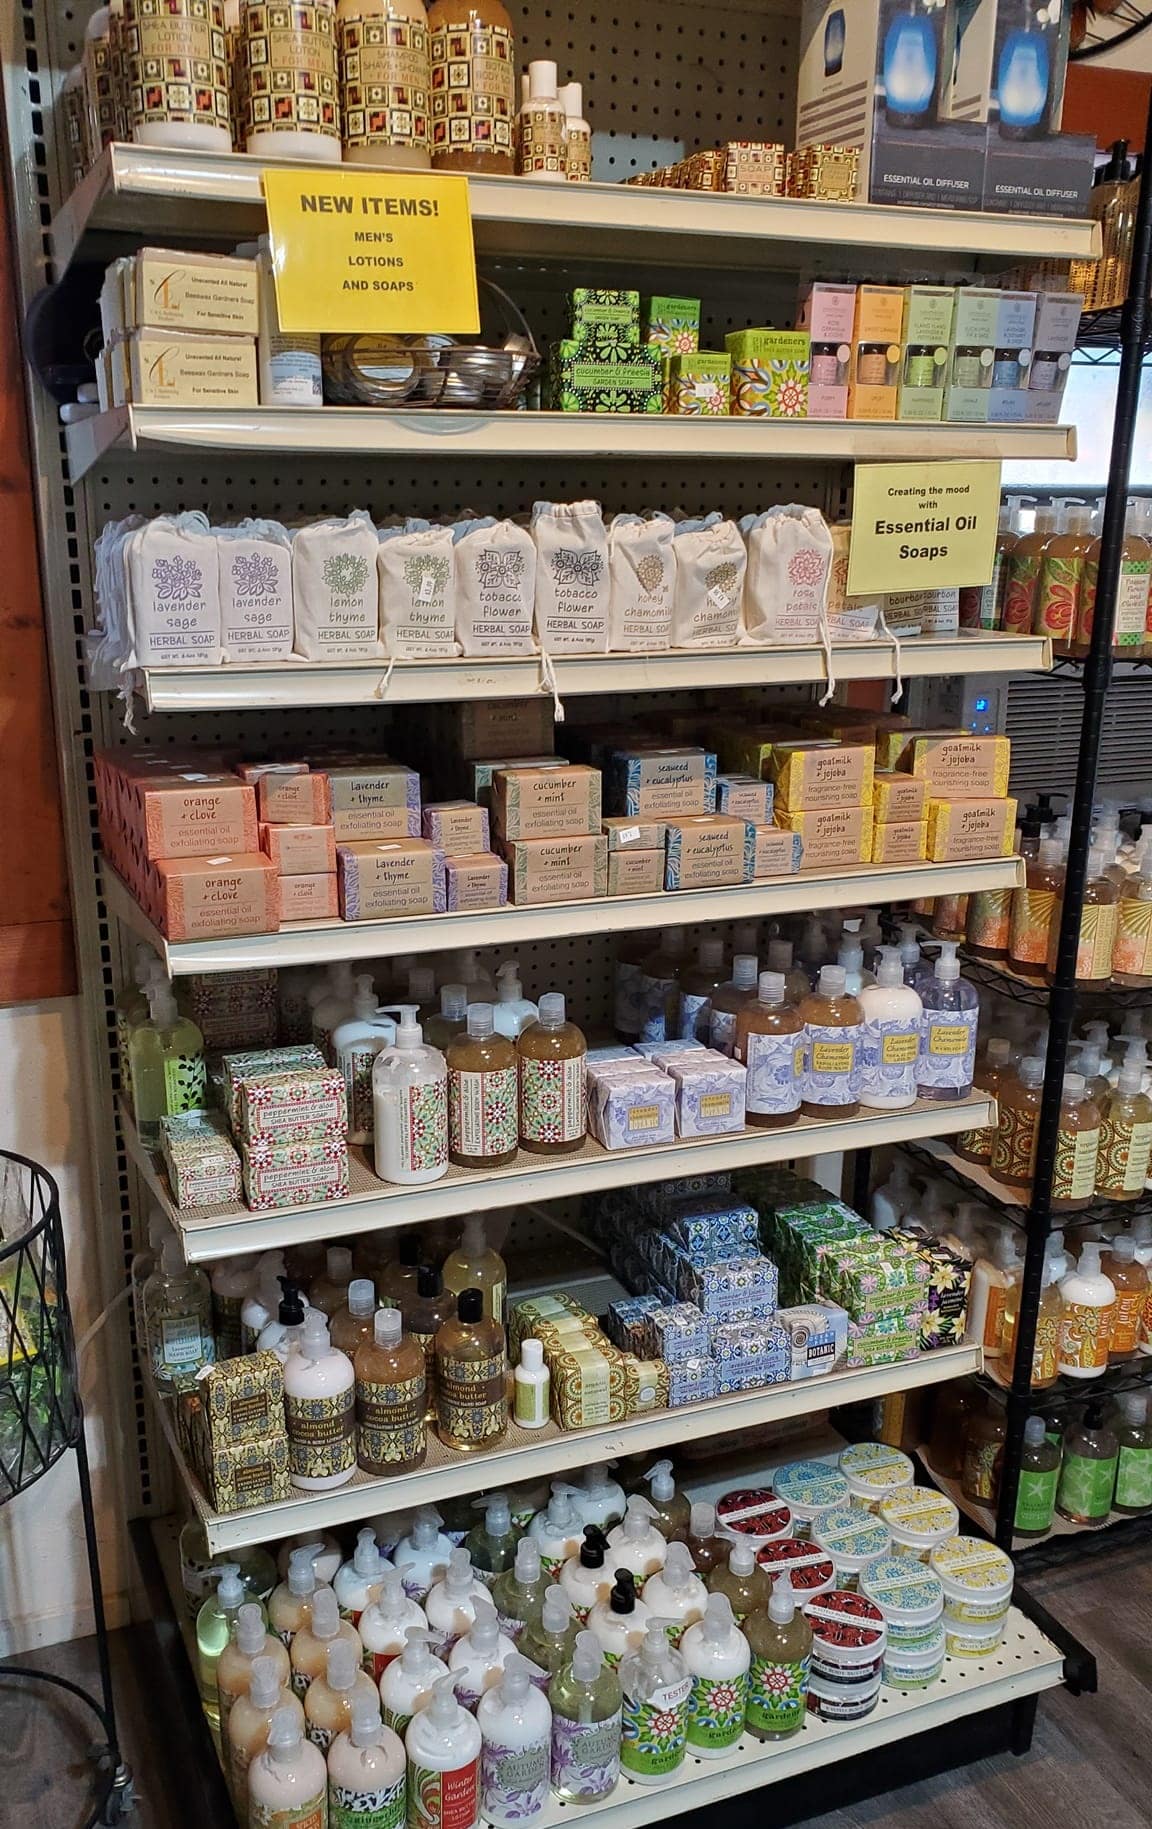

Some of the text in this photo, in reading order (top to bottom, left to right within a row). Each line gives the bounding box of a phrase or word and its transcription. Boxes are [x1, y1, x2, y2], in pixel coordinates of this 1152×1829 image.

[884, 175, 969, 189] ESSENTIAL OIL DIFFUSER
[996, 185, 1078, 198] ESSENTIAL OIL DIFFUSER
[300, 195, 439, 217] NEW ITEMS!
[354, 232, 393, 243] MEN'S
[348, 256, 403, 267] LOTIONS
[342, 280, 414, 291] AND SOAPS
[666, 303, 697, 312] gardeners
[764, 336, 806, 346] gardeners
[576, 367, 613, 376] cucumber
[887, 485, 970, 498] Creating the mood
[918, 500, 938, 509] with
[875, 515, 977, 535] Essential Oil
[899, 545, 948, 560] Soaps
[554, 588, 597, 598] tobacco
[152, 600, 206, 612] lavender
[232, 596, 282, 608] lavender
[330, 598, 364, 608] lemon
[557, 601, 594, 614] flower
[329, 611, 365, 623] thyme
[483, 605, 522, 618] flower
[166, 617, 198, 629] sage
[244, 612, 273, 623] sage
[409, 611, 446, 624] thyme
[473, 625, 529, 634] HERBAL SOAP
[547, 620, 604, 630] HERBAL SOAP
[150, 634, 214, 646] HERBAL SOAP
[228, 630, 289, 641] HERBAL SOAP
[318, 630, 375, 641] HERBAL SOAP
[942, 743, 981, 756] goatmilk
[817, 756, 852, 770] goatmilk
[949, 756, 975, 766] jojoba
[658, 762, 688, 772] seaweed
[823, 769, 846, 780] jojoba
[933, 771, 988, 779] fragrance-free
[533, 780, 576, 791] cucumber
[652, 775, 693, 789] eucalyptus
[808, 784, 856, 794] fragrance-free
[184, 797, 221, 807] orange
[359, 795, 384, 806] thyme
[544, 793, 565, 802] mint
[805, 792, 857, 802] nourishing soap
[644, 799, 698, 810] exfoliating soap
[190, 811, 216, 821] clove
[348, 811, 383, 819] essential
[533, 809, 567, 818] essential
[817, 813, 851, 824] goatmilk
[963, 809, 996, 823] goatmilk
[340, 820, 402, 831] exfoliating soap
[525, 817, 584, 829] exfoliating soap
[967, 821, 990, 833] jojoba
[179, 826, 230, 836] essential oil
[823, 825, 845, 836] jojoba
[170, 836, 239, 848] exfoliating soap
[699, 832, 728, 842] seaweed
[541, 845, 582, 856] cucumber
[693, 844, 733, 857] eucalyptus
[808, 840, 856, 850] fragrance-free
[950, 843, 999, 853] nourishing soap
[805, 848, 857, 858] nourishing soap
[551, 857, 570, 866] mint
[692, 861, 722, 869] essential
[384, 872, 410, 884] thyme
[539, 873, 572, 882] essential
[685, 870, 720, 879] exfoliating
[205, 877, 243, 889] orange
[532, 881, 589, 892] exfoliating soap
[211, 891, 238, 901] clove
[373, 889, 408, 897] essential
[365, 896, 428, 908] exfoliating soap
[200, 905, 251, 917] essential oil
[191, 915, 260, 929] exfoliating soap
[263, 1106, 310, 1118] peppermint
[288, 1115, 310, 1123] BUTTER
[311, 1112, 328, 1120] SOAP
[264, 1170, 310, 1182] peppermint
[319, 1165, 335, 1173] aloe
[289, 1178, 310, 1186] BUTTER
[312, 1175, 328, 1183] SOAP
[808, 1345, 835, 1359] BOTANIC
[459, 1391, 487, 1399] butter
[376, 1406, 408, 1415] almond
[391, 1410, 417, 1421] butter
[302, 1420, 334, 1429] almond
[318, 1426, 343, 1436] butter
[662, 1683, 689, 1700] TESTER
[447, 1774, 474, 1791] Winter
